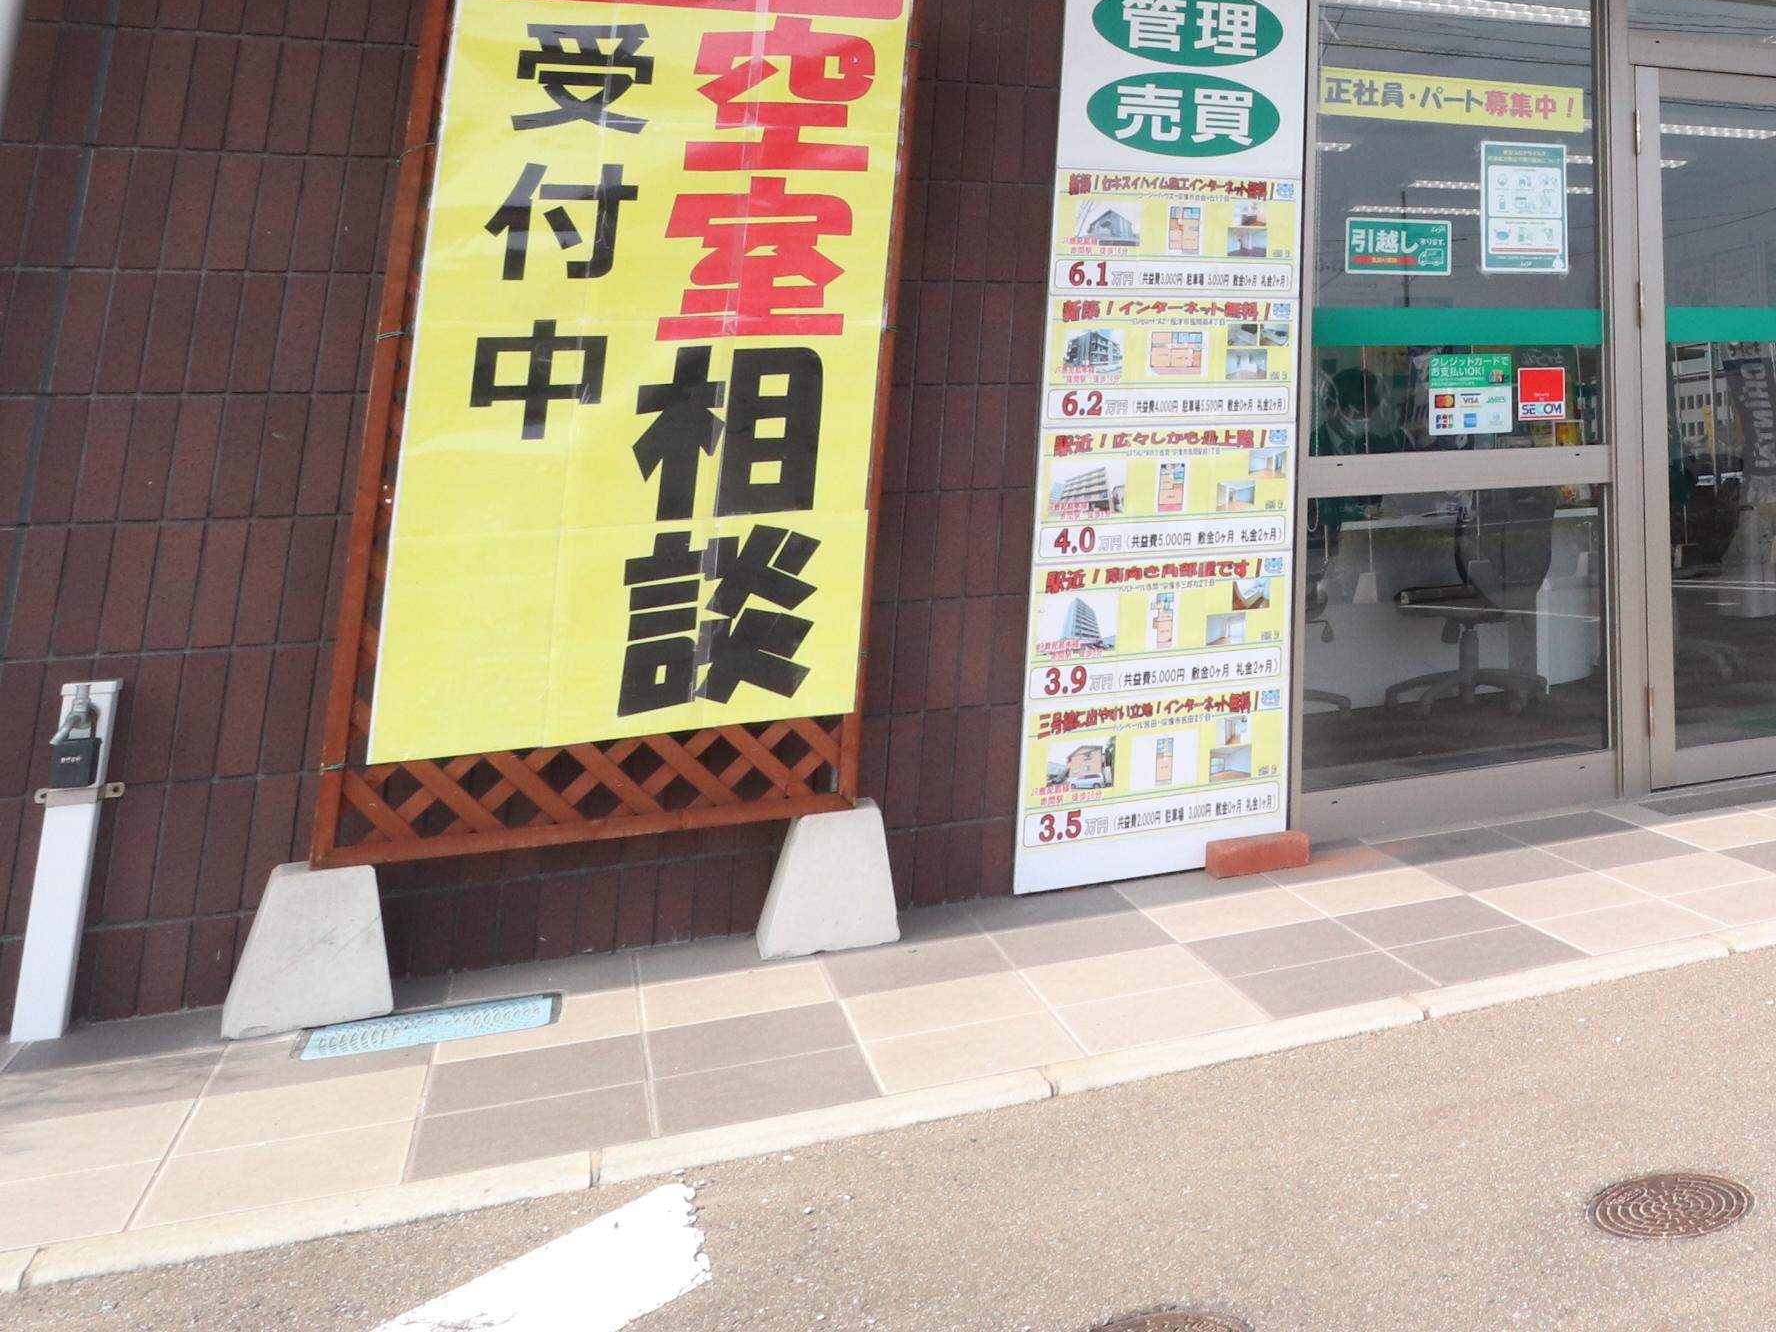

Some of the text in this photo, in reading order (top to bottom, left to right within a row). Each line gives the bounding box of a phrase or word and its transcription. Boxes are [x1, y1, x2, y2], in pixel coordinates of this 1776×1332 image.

[1324, 76, 1575, 120] 正社員・パート募集中！
[1114, 83, 1254, 147] 売買
[469, 22, 655, 441] 受付中
[1351, 228, 1420, 255] 引越し
[1430, 355, 1510, 367] クレジットカードで
[1430, 366, 1486, 378] お支払いOK！
[1462, 396, 1480, 405] VISA
[1521, 403, 1563, 416] SECOM
